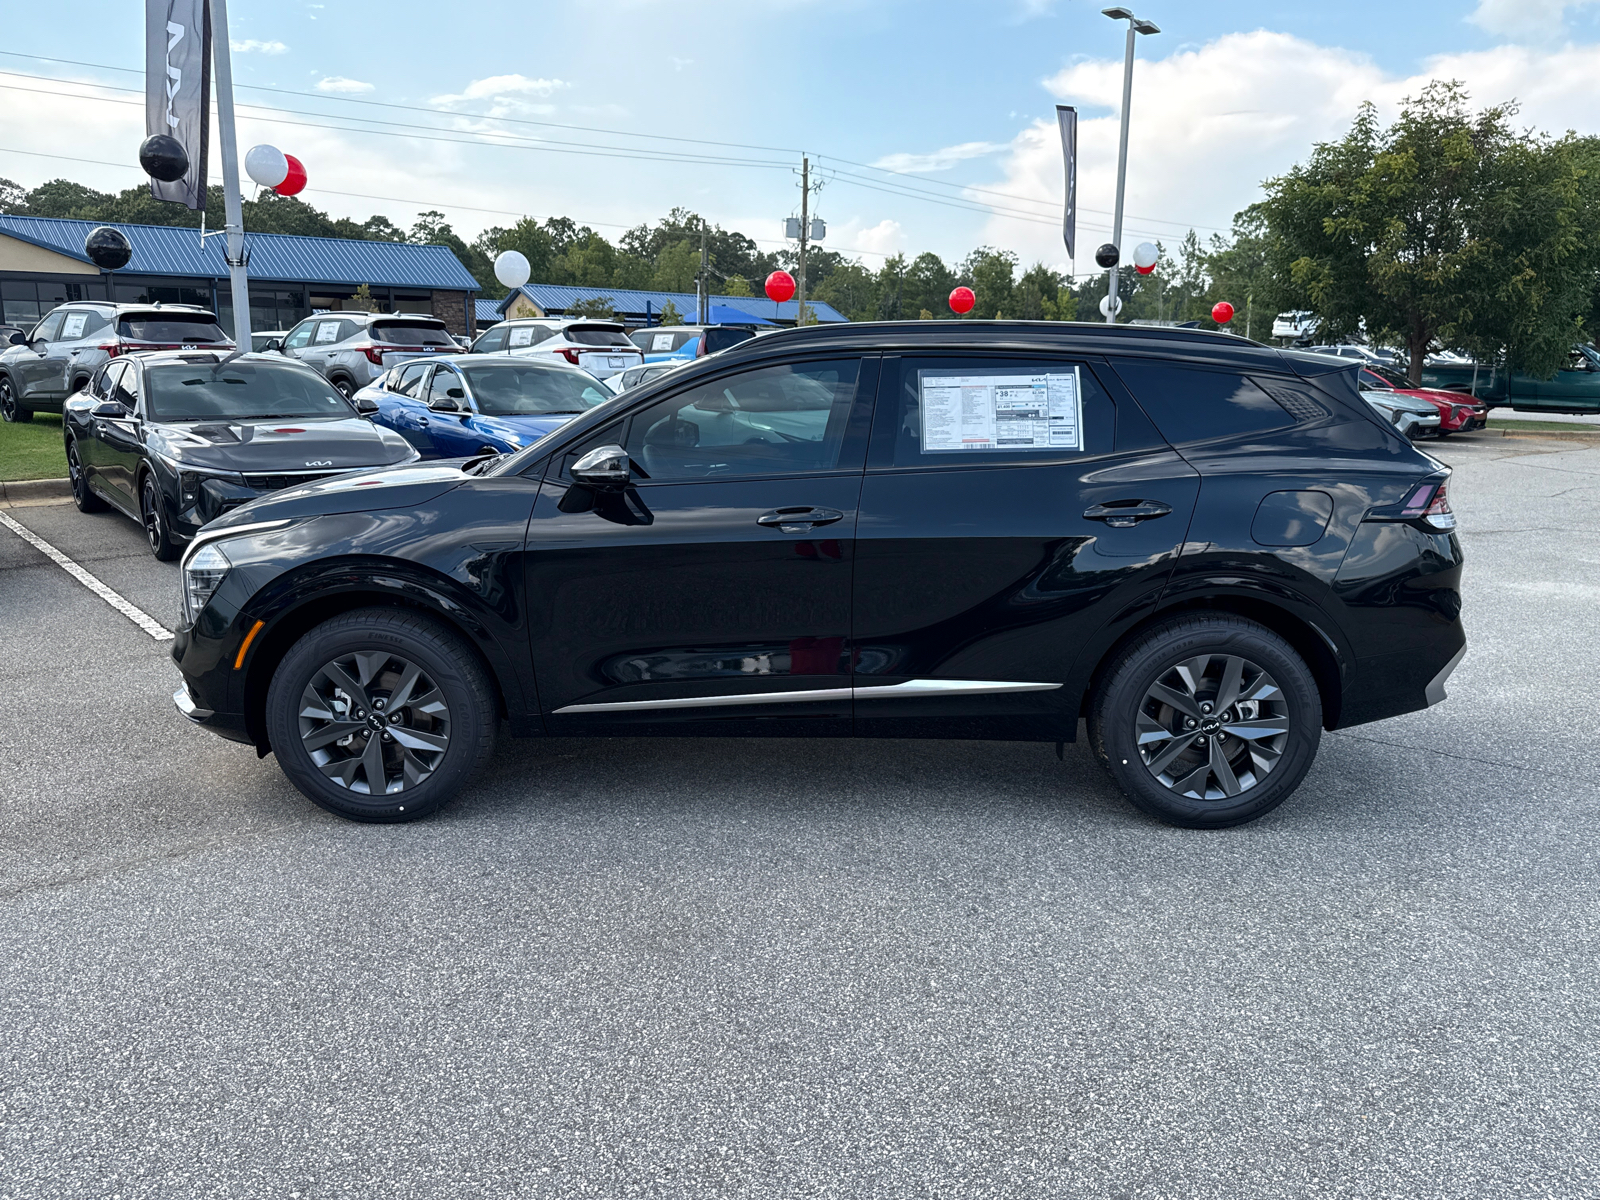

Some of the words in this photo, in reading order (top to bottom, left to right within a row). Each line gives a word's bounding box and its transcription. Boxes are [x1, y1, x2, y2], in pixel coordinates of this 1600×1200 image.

[368, 631, 404, 644] FINESSE
[1257, 643, 1312, 710] ASSURANCE
[1202, 722, 1220, 730] KIA
[1254, 783, 1285, 808] FINESSE
